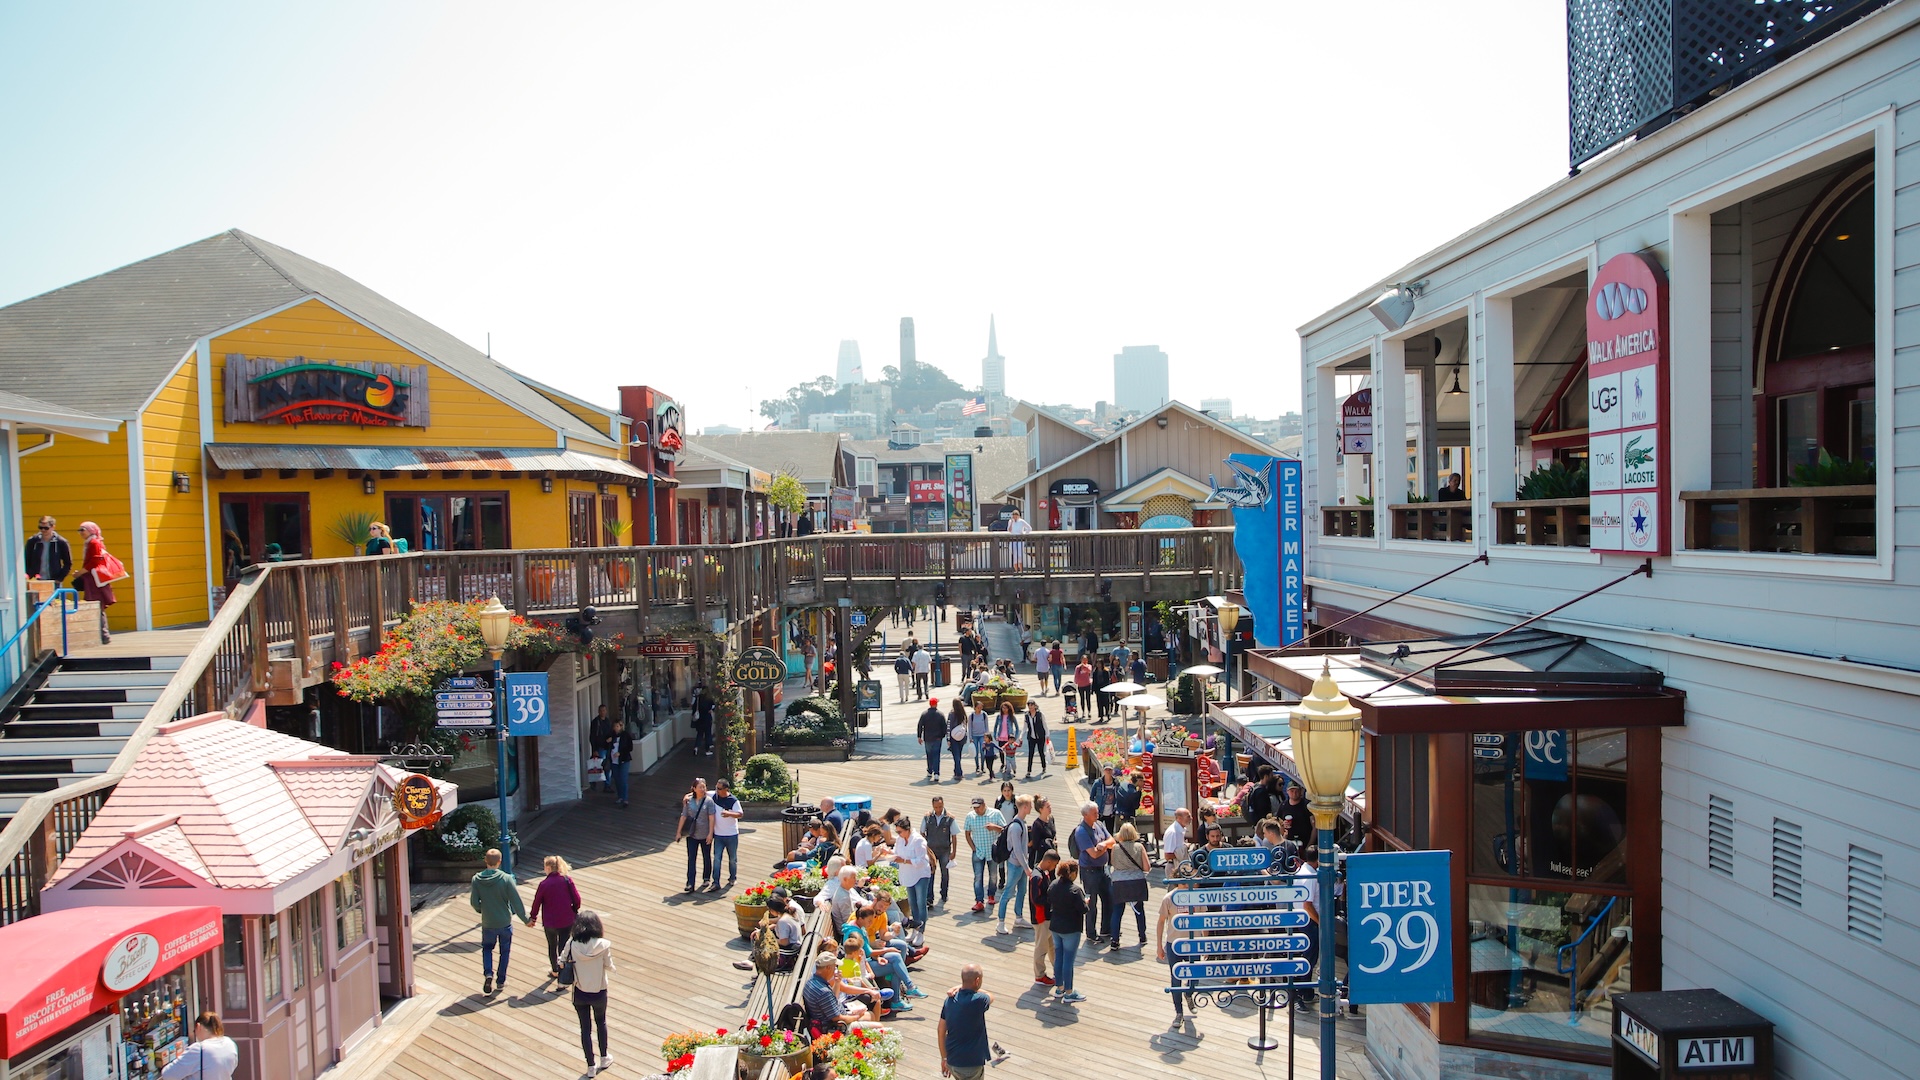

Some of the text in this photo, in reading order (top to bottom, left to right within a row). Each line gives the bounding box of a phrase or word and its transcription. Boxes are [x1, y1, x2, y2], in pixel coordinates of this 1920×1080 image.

[1588, 329, 1657, 365] WALK AMERICA
[1592, 387, 1618, 413] UGG
[281, 407, 388, 426] The Flavor of Mexico
[1344, 405, 1366, 416] WALK
[1632, 410, 1646, 422] POLO
[1595, 452, 1614, 466] TOMS
[1624, 470, 1654, 484] LACOSTE
[1630, 500, 1650, 516] CONVERSE
[1284, 467, 1298, 640] PIER MARKET
[751, 660, 776, 668] Francisco
[736, 667, 780, 680] GOLD
[512, 684, 543, 696] PIER
[512, 697, 545, 724] 39
[1268, 747, 1280, 764] CLAM
[405, 786, 431, 794] Charms
[1216, 852, 1265, 867] PIER 39
[1198, 890, 1278, 903] SWISS LOUIS
[1360, 880, 1435, 909] PIER
[1203, 915, 1281, 928] RESTROOMS
[164, 920, 216, 952] COFFEE ESPRESSO
[1358, 910, 1439, 974] 39
[161, 928, 219, 962] ICED COFFEE DRINKS
[1197, 939, 1291, 952] LEVEL 2 SHOPS
[114, 962, 151, 986] COFFEE CART
[1205, 964, 1272, 976] BAY VIEWS
[46, 988, 66, 1004] FREE
[23, 986, 87, 1026] BISCOFF COOKIE
[16, 992, 94, 1039] SERVED WITH EVERY COFFEE
[1625, 1017, 1655, 1056] ATM
[1684, 1039, 1744, 1063] ATM
